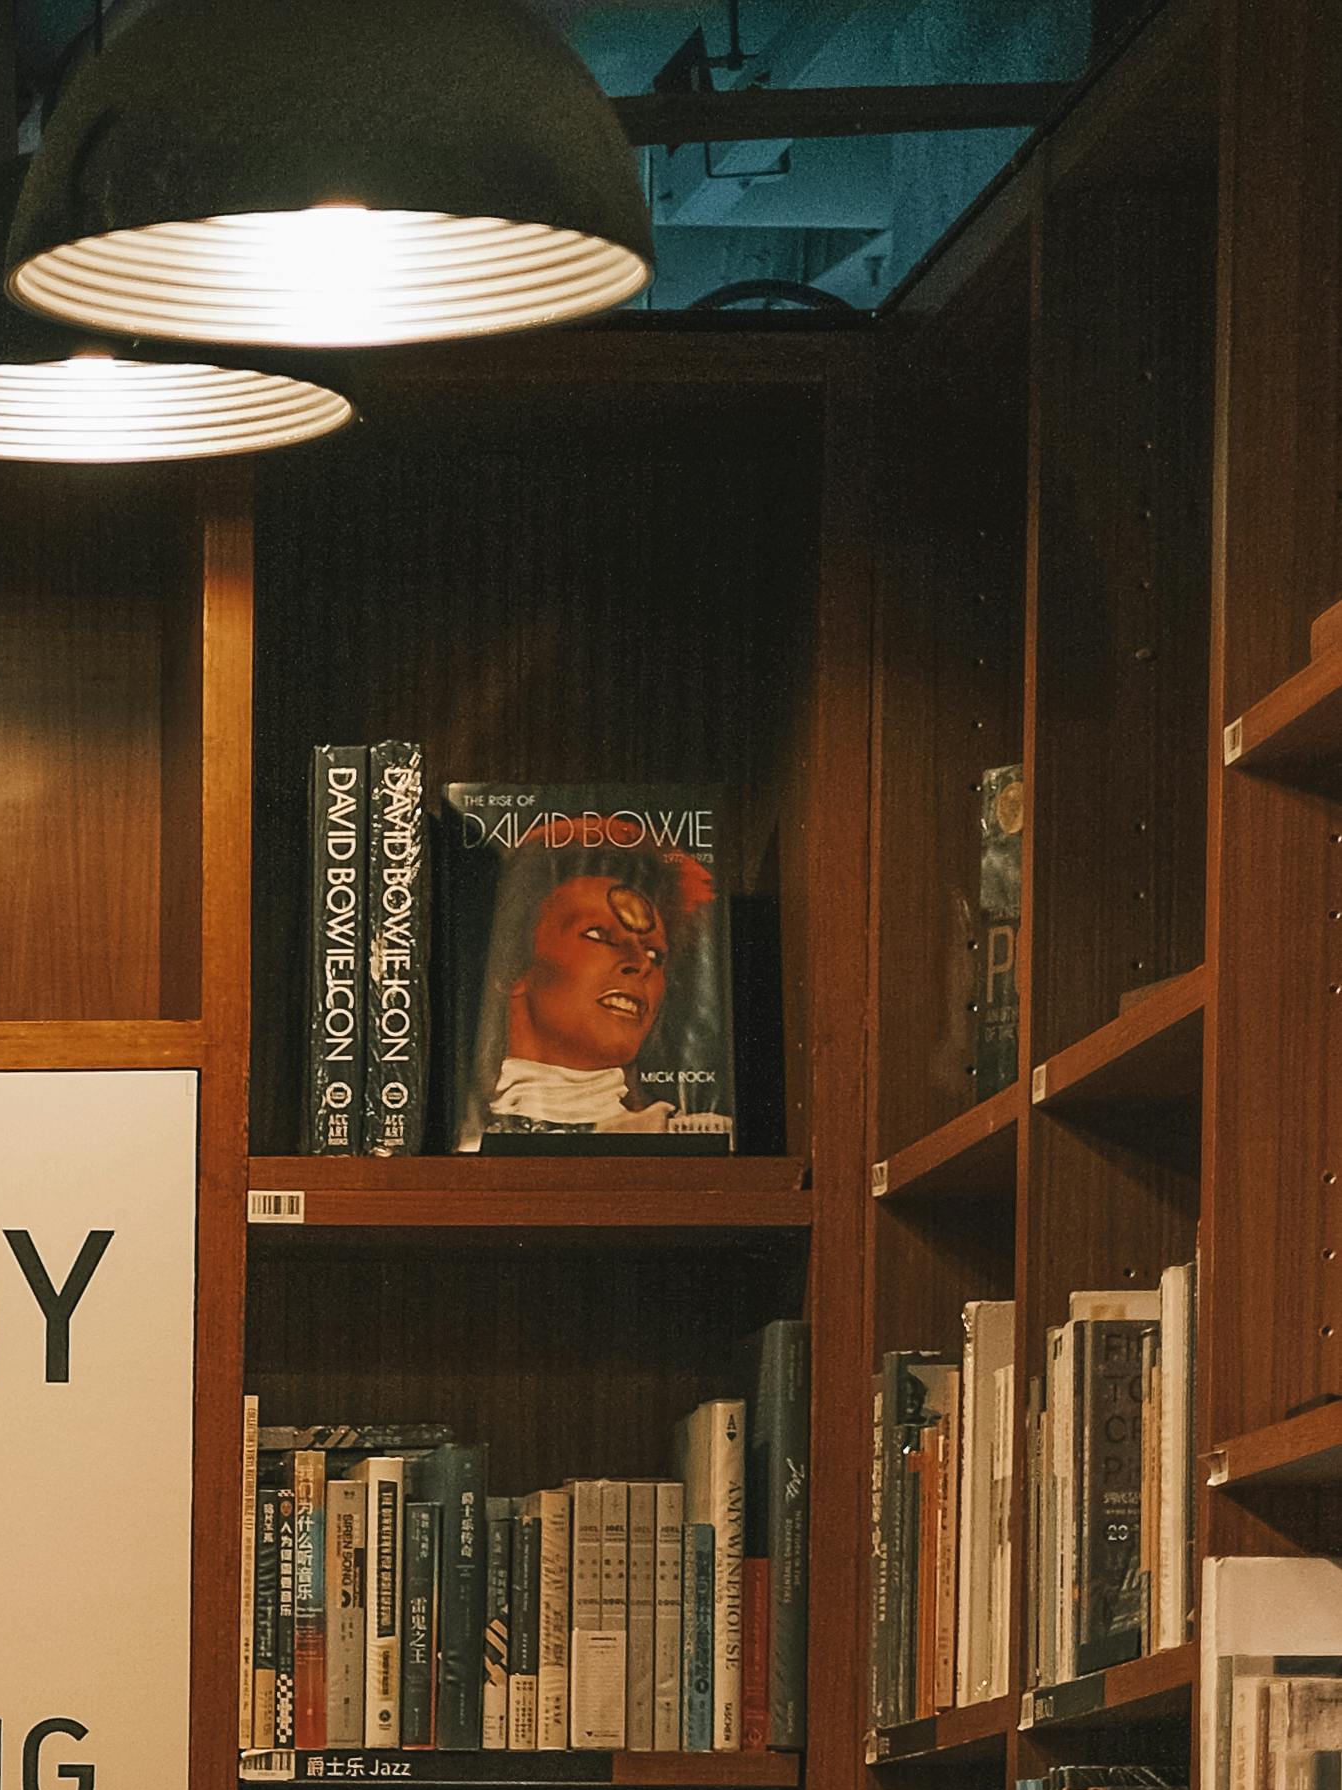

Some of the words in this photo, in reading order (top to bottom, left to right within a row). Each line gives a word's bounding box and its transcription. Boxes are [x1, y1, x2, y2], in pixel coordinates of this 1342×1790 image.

[327, 768, 357, 860] DAVID
[383, 768, 414, 860] DAVID
[464, 795, 483, 806] THE
[487, 795, 513, 806] RISE
[517, 795, 535, 806] OF
[464, 810, 575, 850] DAVID
[582, 810, 713, 850] BOWIE
[326, 868, 356, 970] BOWIE
[640, 1071, 674, 1084] MICK
[679, 1071, 715, 1084] ROCK
[726, 1480, 742, 1532] AMY
[342, 1552, 354, 1588] SONG
[725, 1533, 743, 1671] WINEHOUSE
[306, 1757, 366, 1779] 爵士乐
[369, 1757, 412, 1778] Jazz
